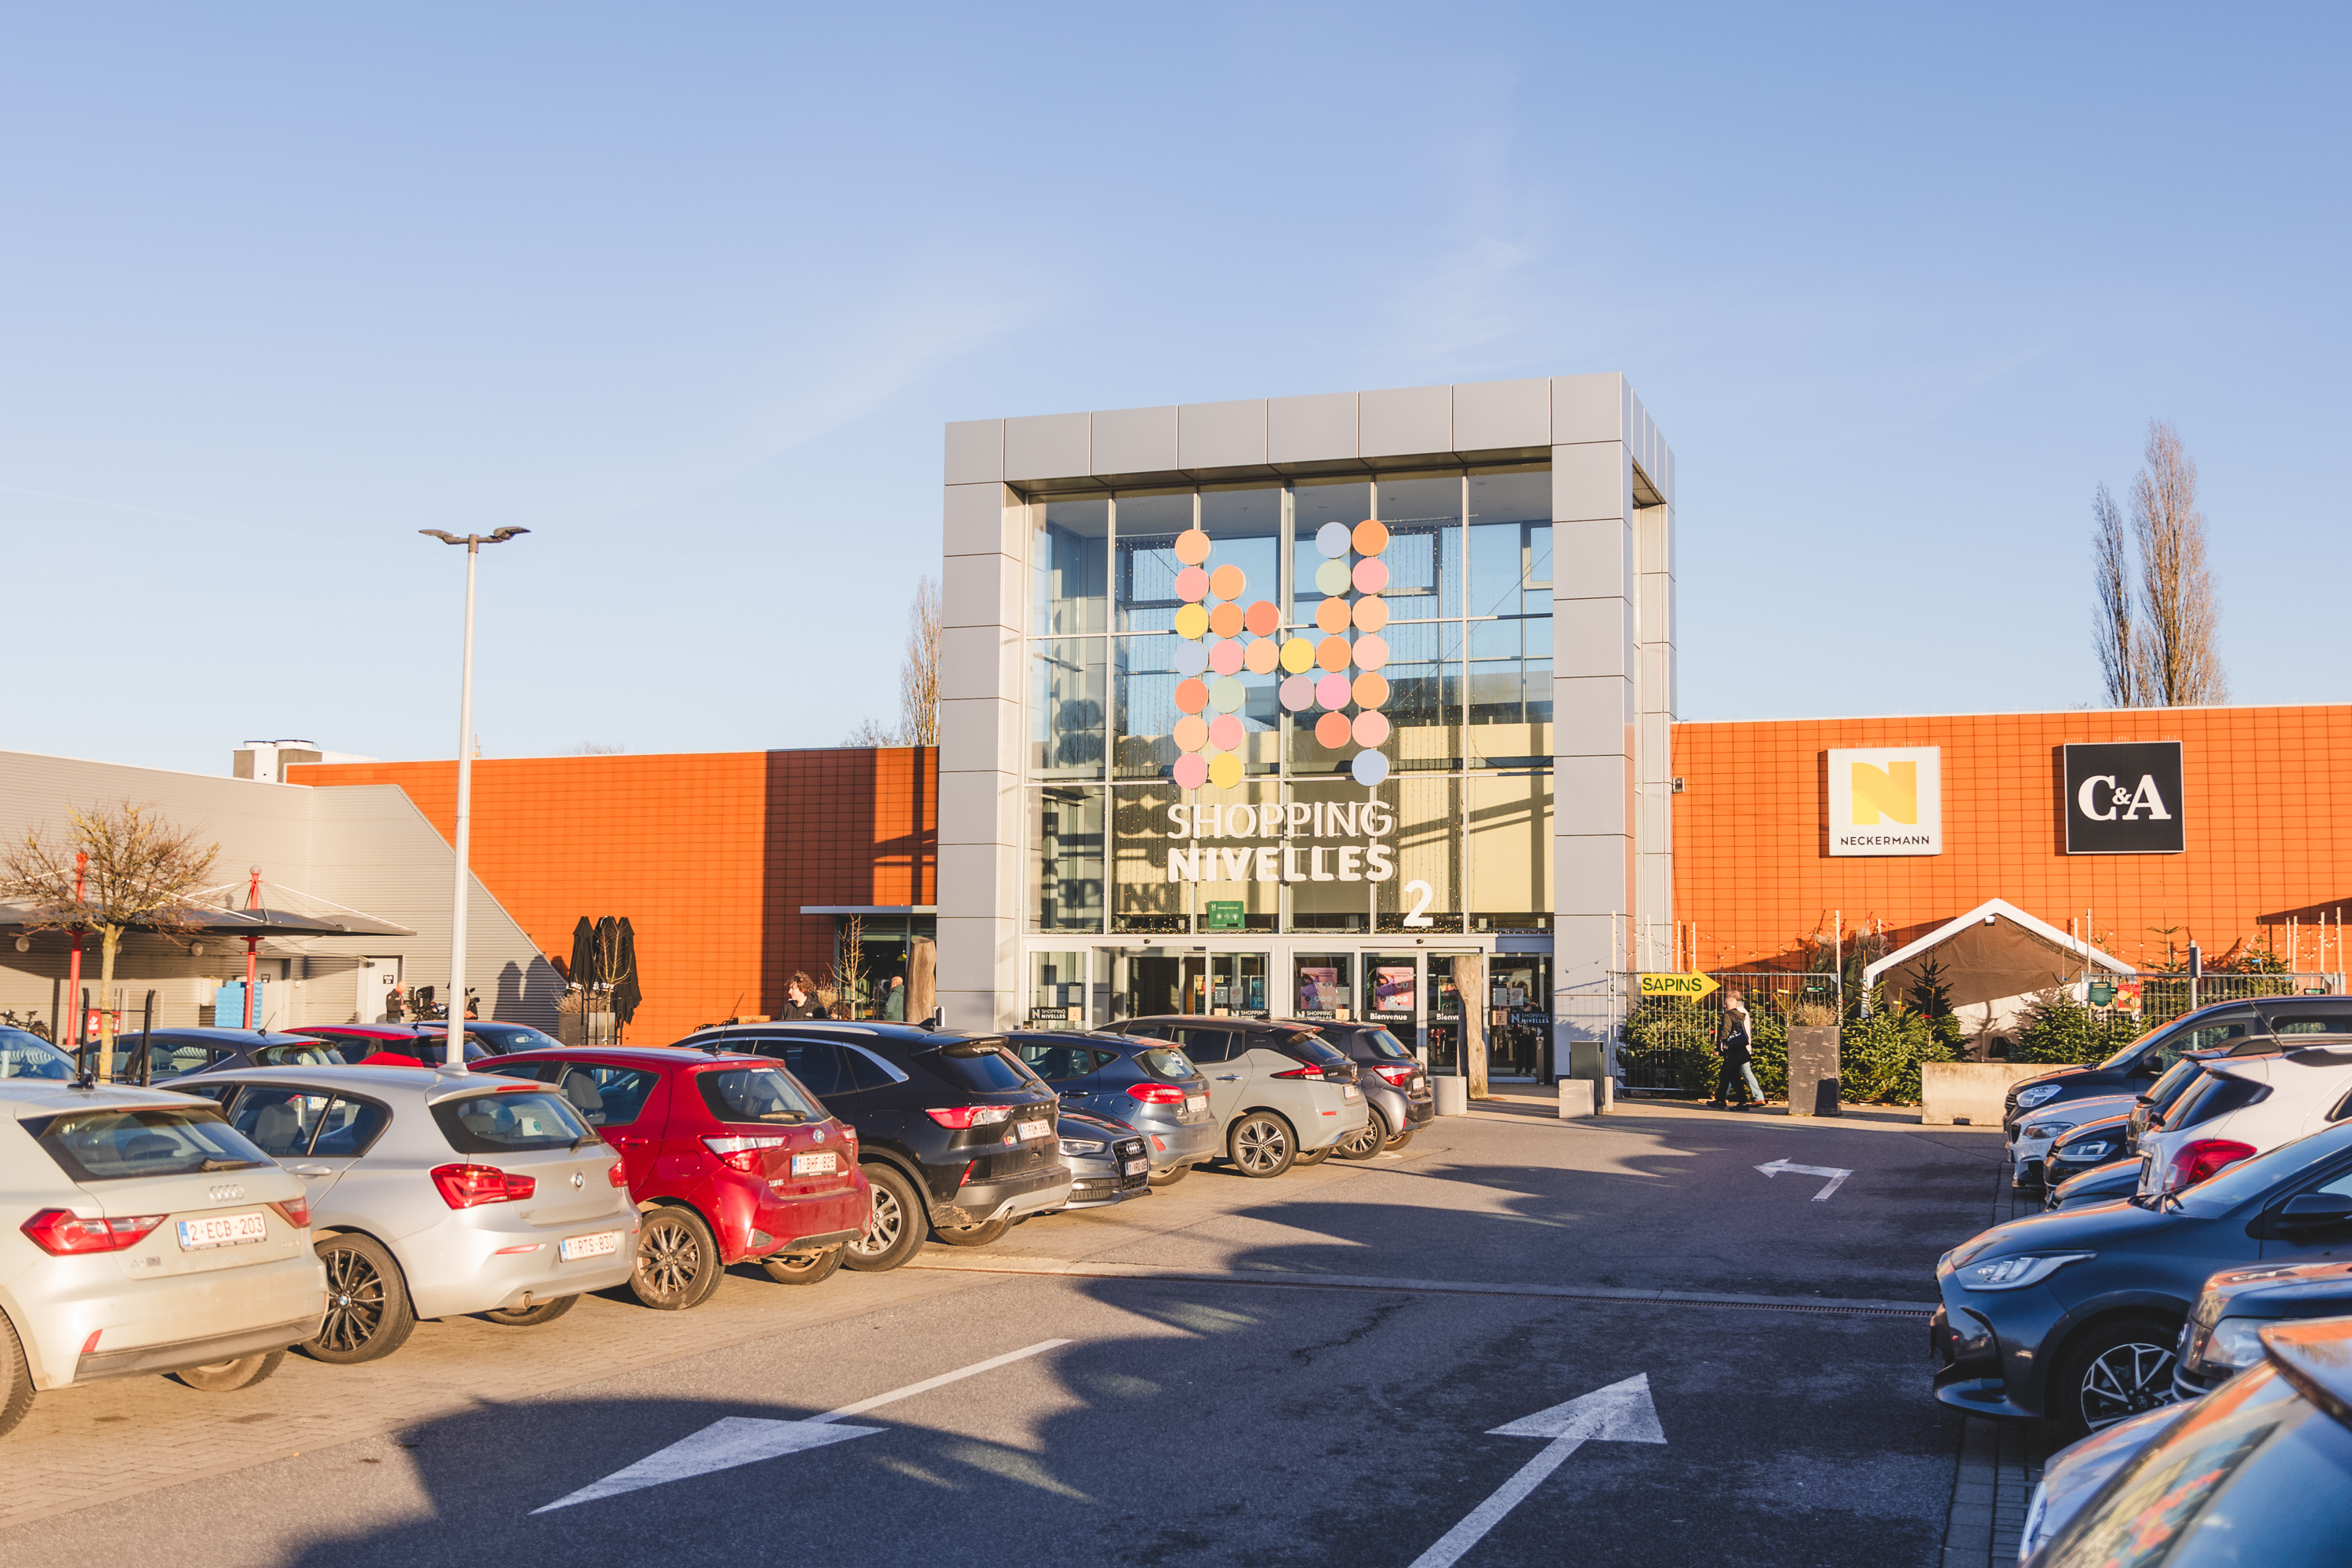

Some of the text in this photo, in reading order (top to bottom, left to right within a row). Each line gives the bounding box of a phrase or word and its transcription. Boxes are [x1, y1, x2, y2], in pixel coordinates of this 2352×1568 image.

[2078, 775, 2172, 821] C&A
[1167, 800, 1392, 839] SHOPPING
[1840, 836, 1930, 846] NECKERMANN
[1167, 844, 1394, 883] NIVELLES
[1403, 879, 1434, 927] 2
[1642, 978, 1702, 991] SAPINS
[798, 1156, 835, 1171] 1-BHF-825
[190, 1217, 263, 1241] 2-ECB-203
[568, 1235, 615, 1256] 1-RTS-830
